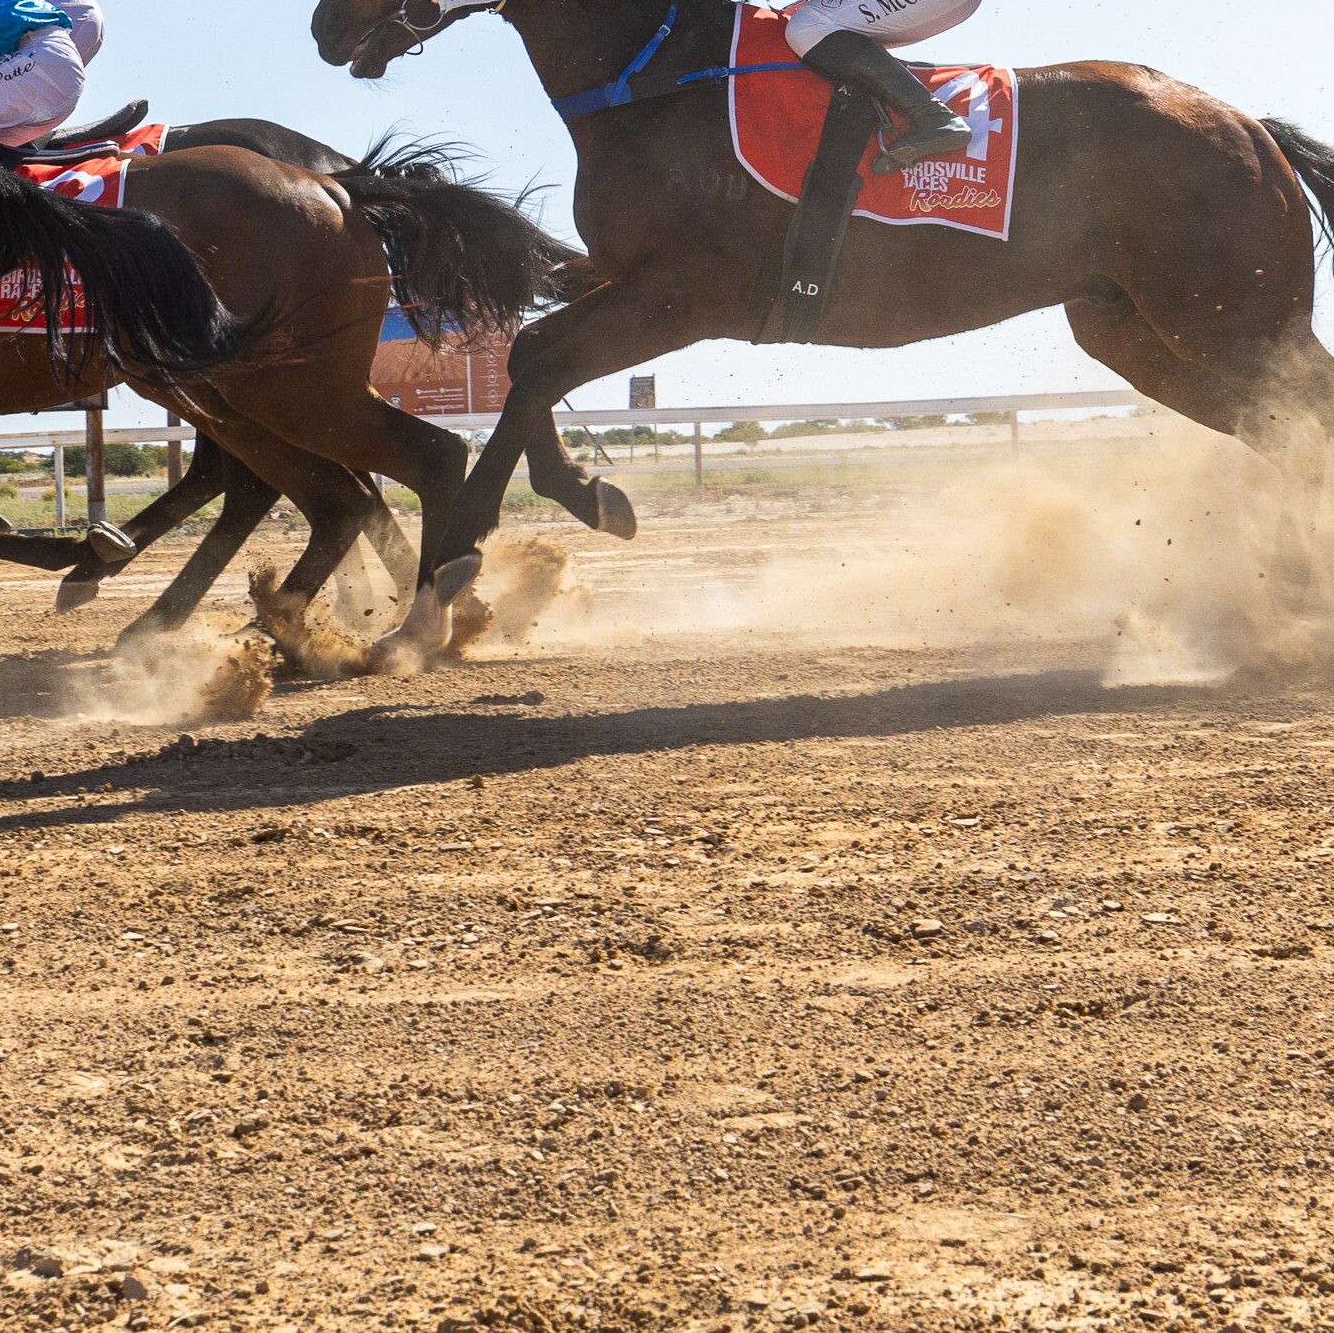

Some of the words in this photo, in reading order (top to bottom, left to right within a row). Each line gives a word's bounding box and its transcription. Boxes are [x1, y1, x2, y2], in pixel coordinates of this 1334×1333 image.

[858, 2, 881, 24] S.
[909, 185, 1002, 212] Roadies
[792, 280, 819, 297] A.D
